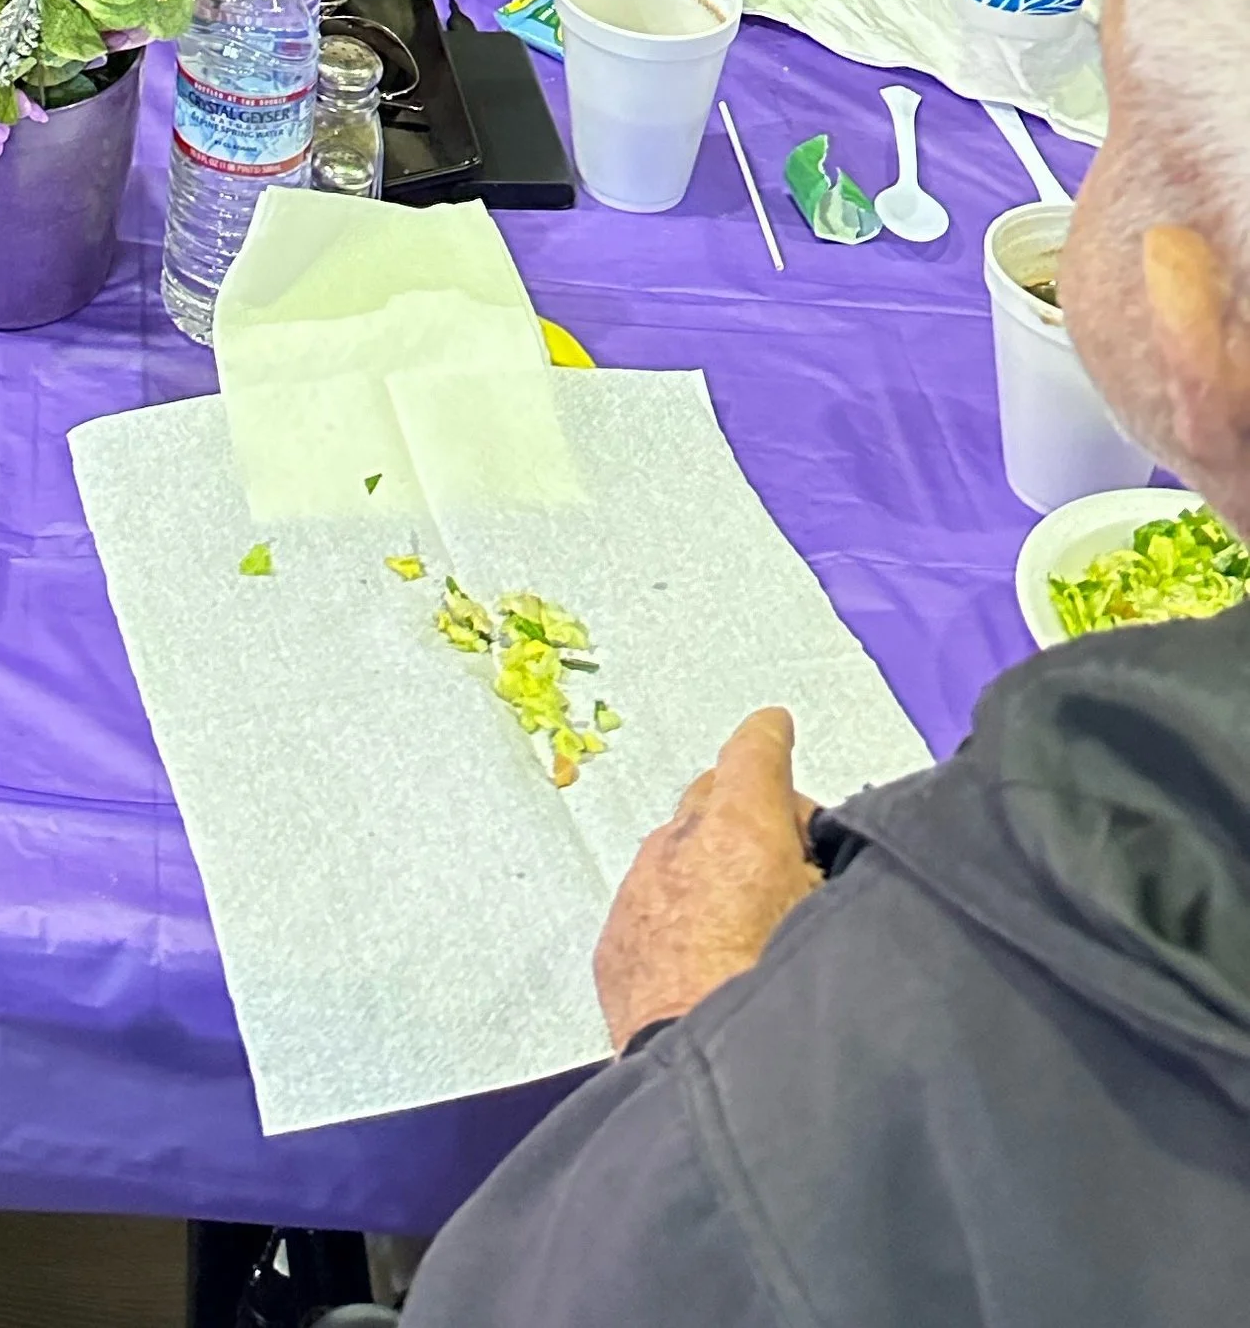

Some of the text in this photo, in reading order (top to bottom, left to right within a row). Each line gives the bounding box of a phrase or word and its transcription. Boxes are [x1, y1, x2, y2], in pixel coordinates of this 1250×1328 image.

[227, 94, 237, 104] AT
[188, 91, 291, 124] CRYSTAL GEYSER
[220, 125, 255, 139] SPRING
[255, 128, 285, 139] WATER
